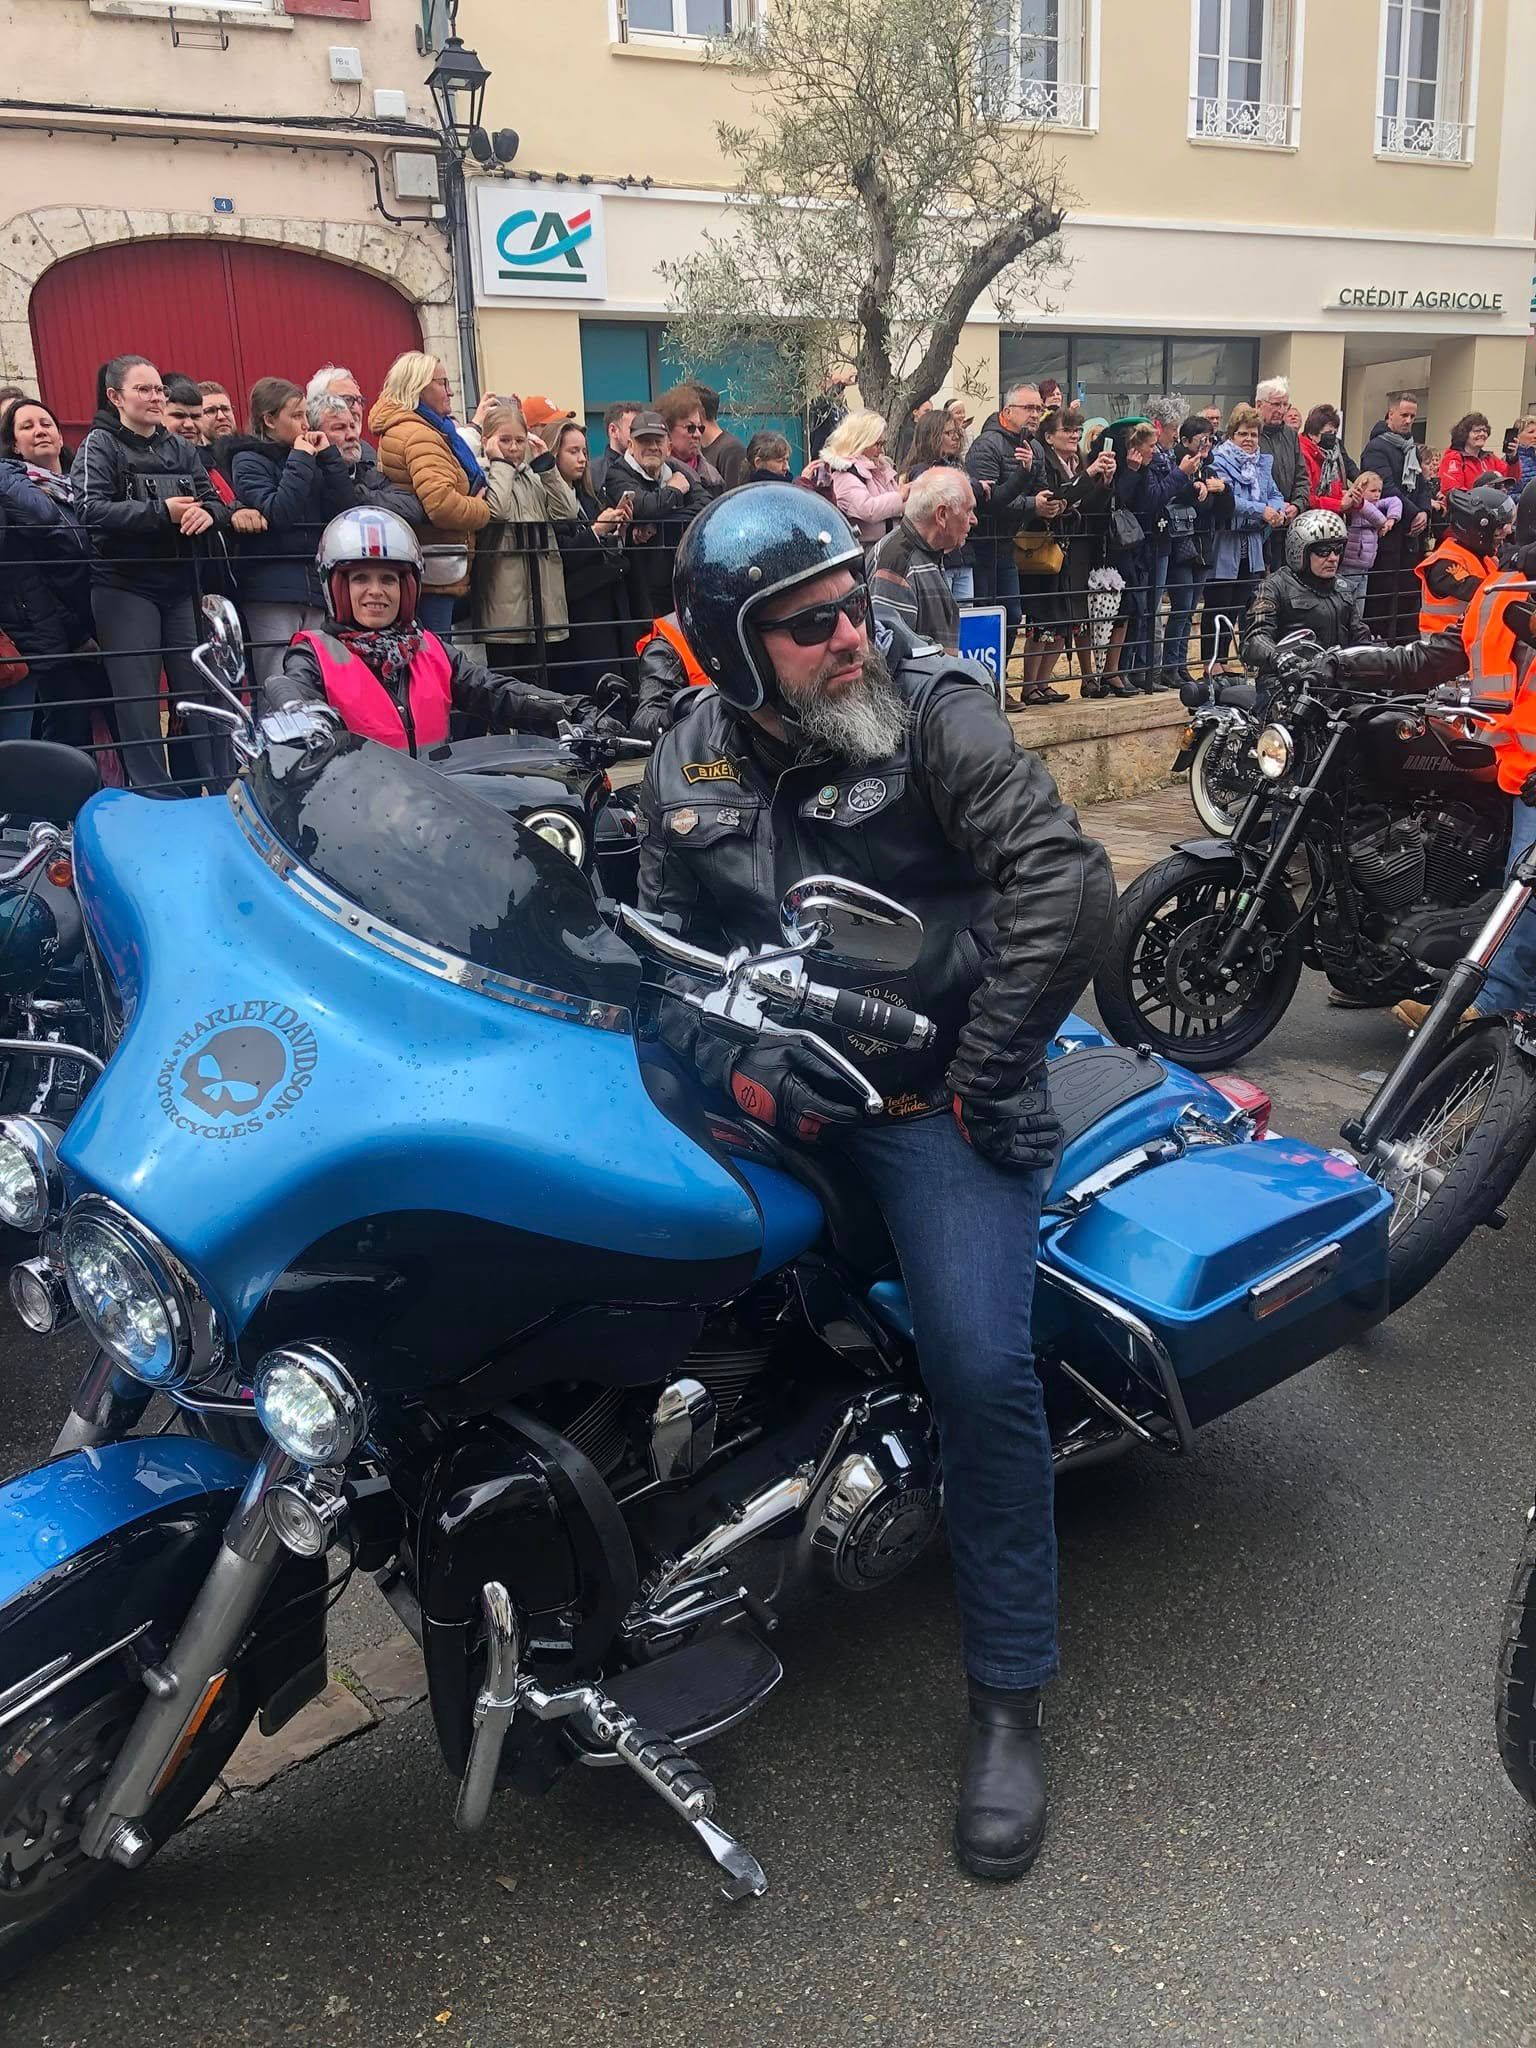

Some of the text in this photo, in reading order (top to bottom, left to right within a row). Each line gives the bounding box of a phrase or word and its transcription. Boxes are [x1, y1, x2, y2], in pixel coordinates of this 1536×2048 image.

[1339, 286, 1503, 310] CRÉDIT AGRICOLE
[864, 988, 880, 999] TO
[847, 1034, 866, 1051] LIVE
[175, 1000, 318, 1118] HARLEY DAVIDSON
[157, 1057, 264, 1139] MOTORCYCLES
[887, 1100, 931, 1117] Glide
